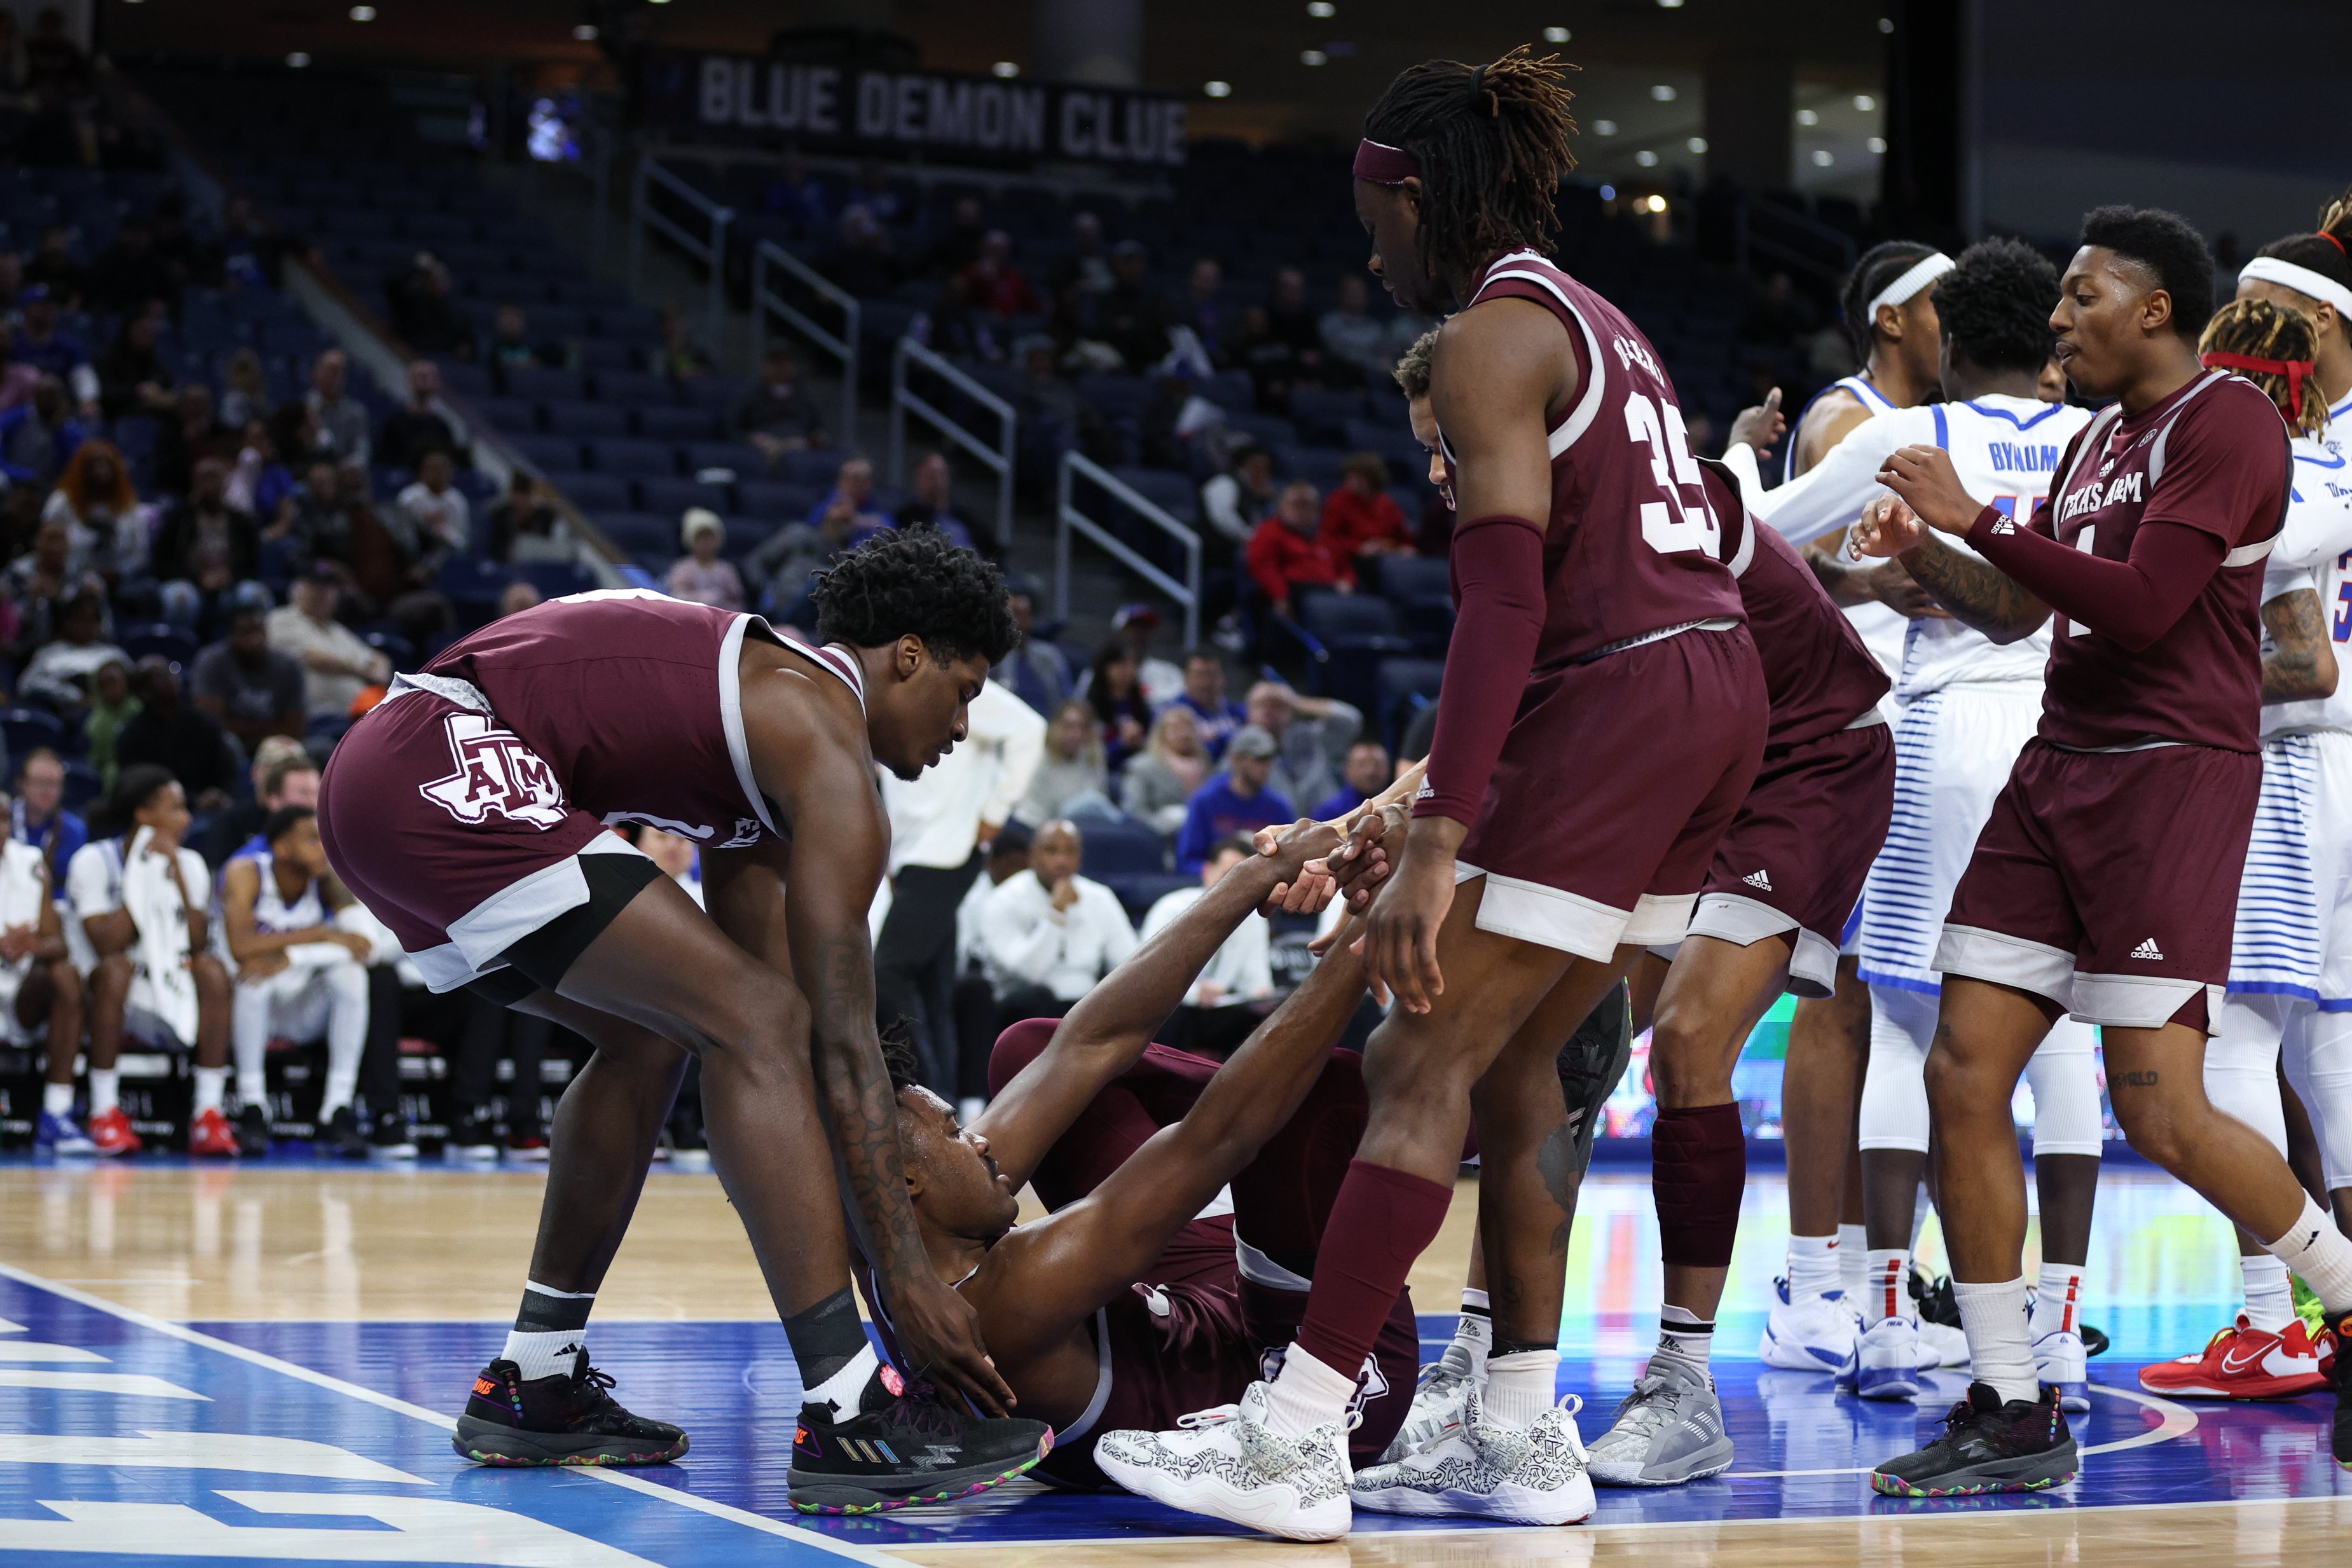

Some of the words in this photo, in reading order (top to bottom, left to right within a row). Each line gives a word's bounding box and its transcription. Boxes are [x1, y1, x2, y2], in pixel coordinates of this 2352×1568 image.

[701, 57, 839, 131] BLUE
[858, 72, 1045, 151] DEMON
[1988, 441, 2058, 472] BYNUM
[2060, 482, 2103, 523] TEXAS
[2101, 471, 2143, 508] A&M
[1742, 877, 1773, 891] adidas
[2130, 950, 2164, 961] adidas
